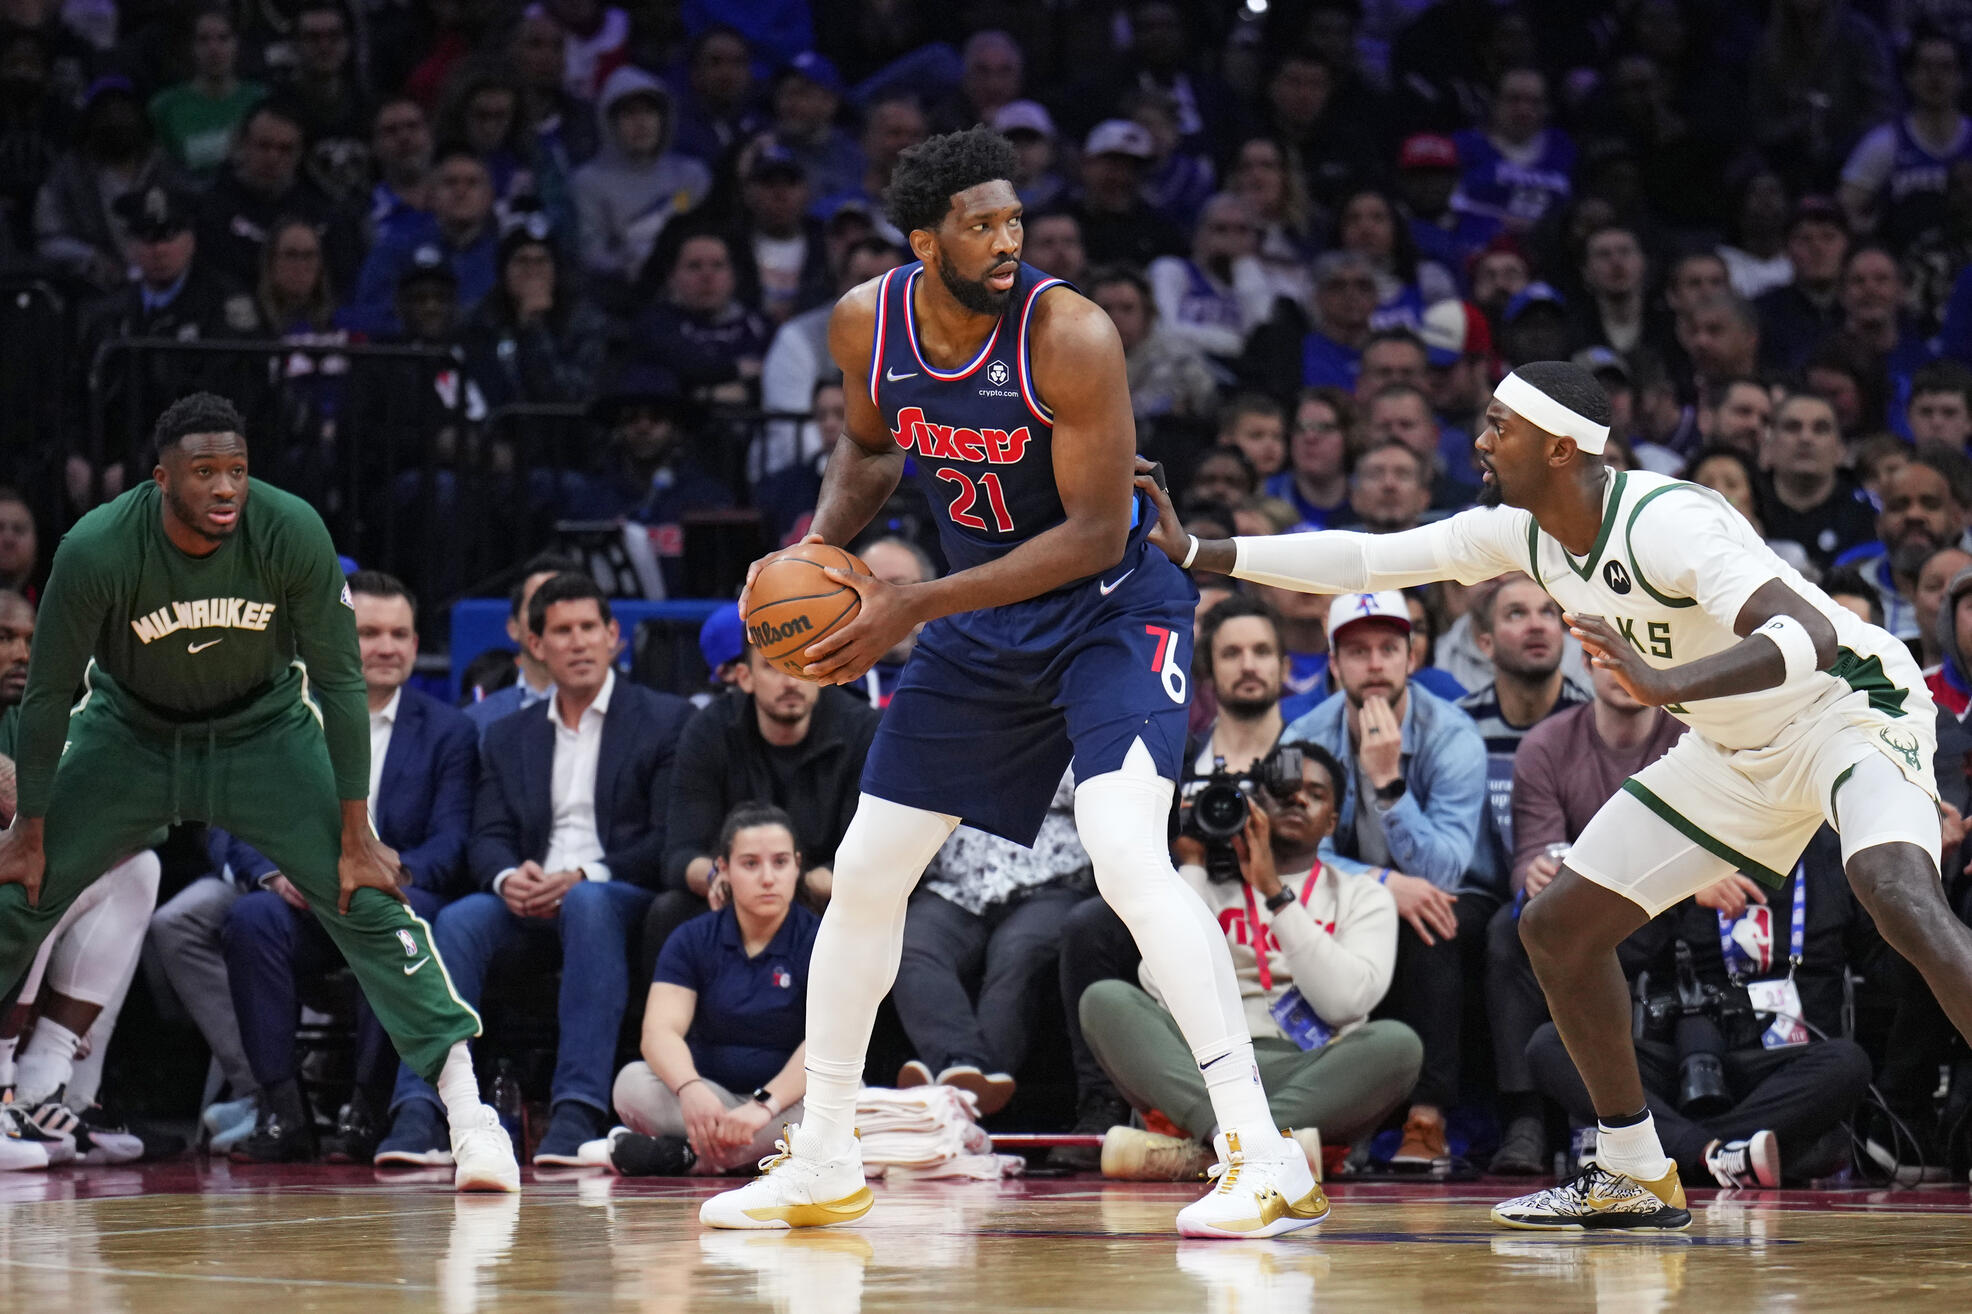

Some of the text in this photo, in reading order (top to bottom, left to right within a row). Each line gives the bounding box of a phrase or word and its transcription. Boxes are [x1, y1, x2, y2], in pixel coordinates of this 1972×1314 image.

[978, 389, 1019, 398] crypto.com
[890, 406, 1032, 464] Sixers
[935, 467, 1015, 533] 21
[130, 597, 276, 645] MILWAUKEE
[1601, 616, 1673, 659] KS
[1145, 623, 1187, 705] 76
